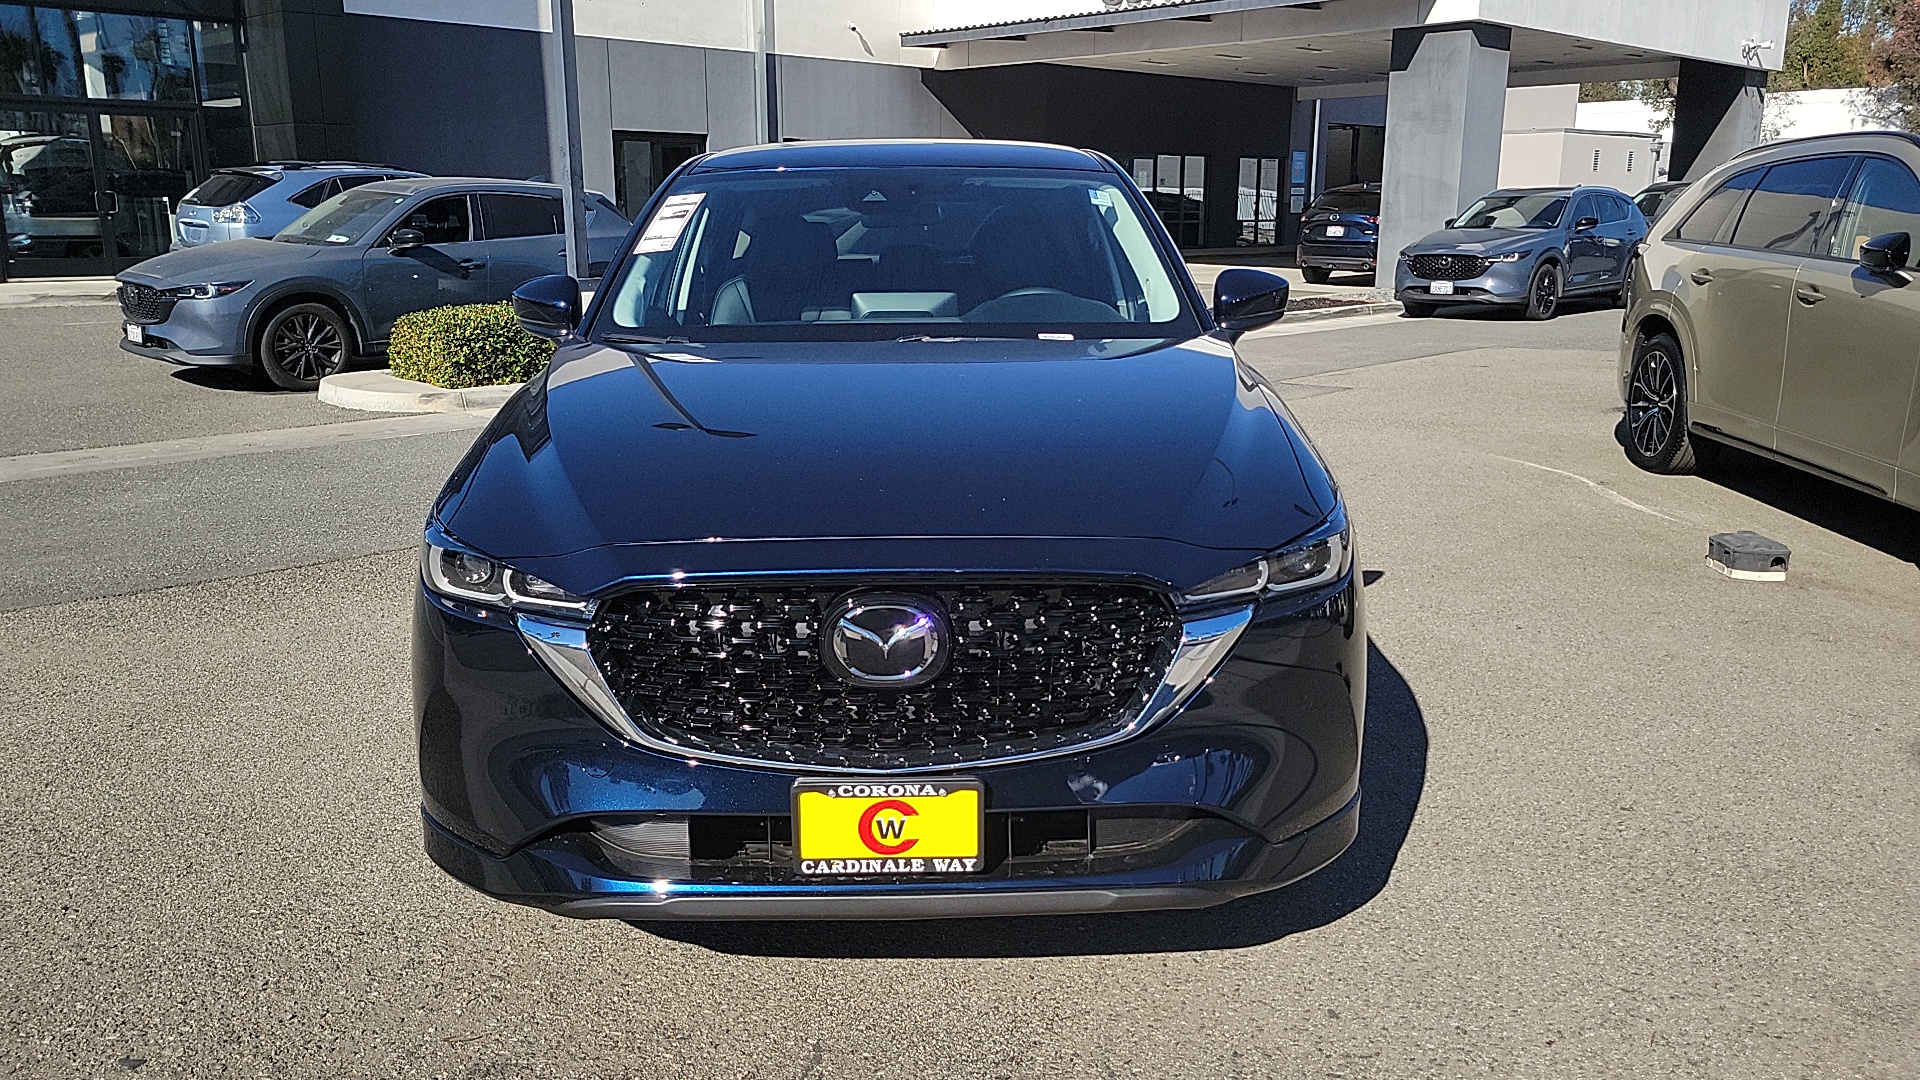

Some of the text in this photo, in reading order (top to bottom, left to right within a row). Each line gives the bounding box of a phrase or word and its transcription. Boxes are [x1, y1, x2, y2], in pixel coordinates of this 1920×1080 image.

[837, 785, 938, 797] CORONA
[801, 858, 977, 874] CARDINALE WAY
